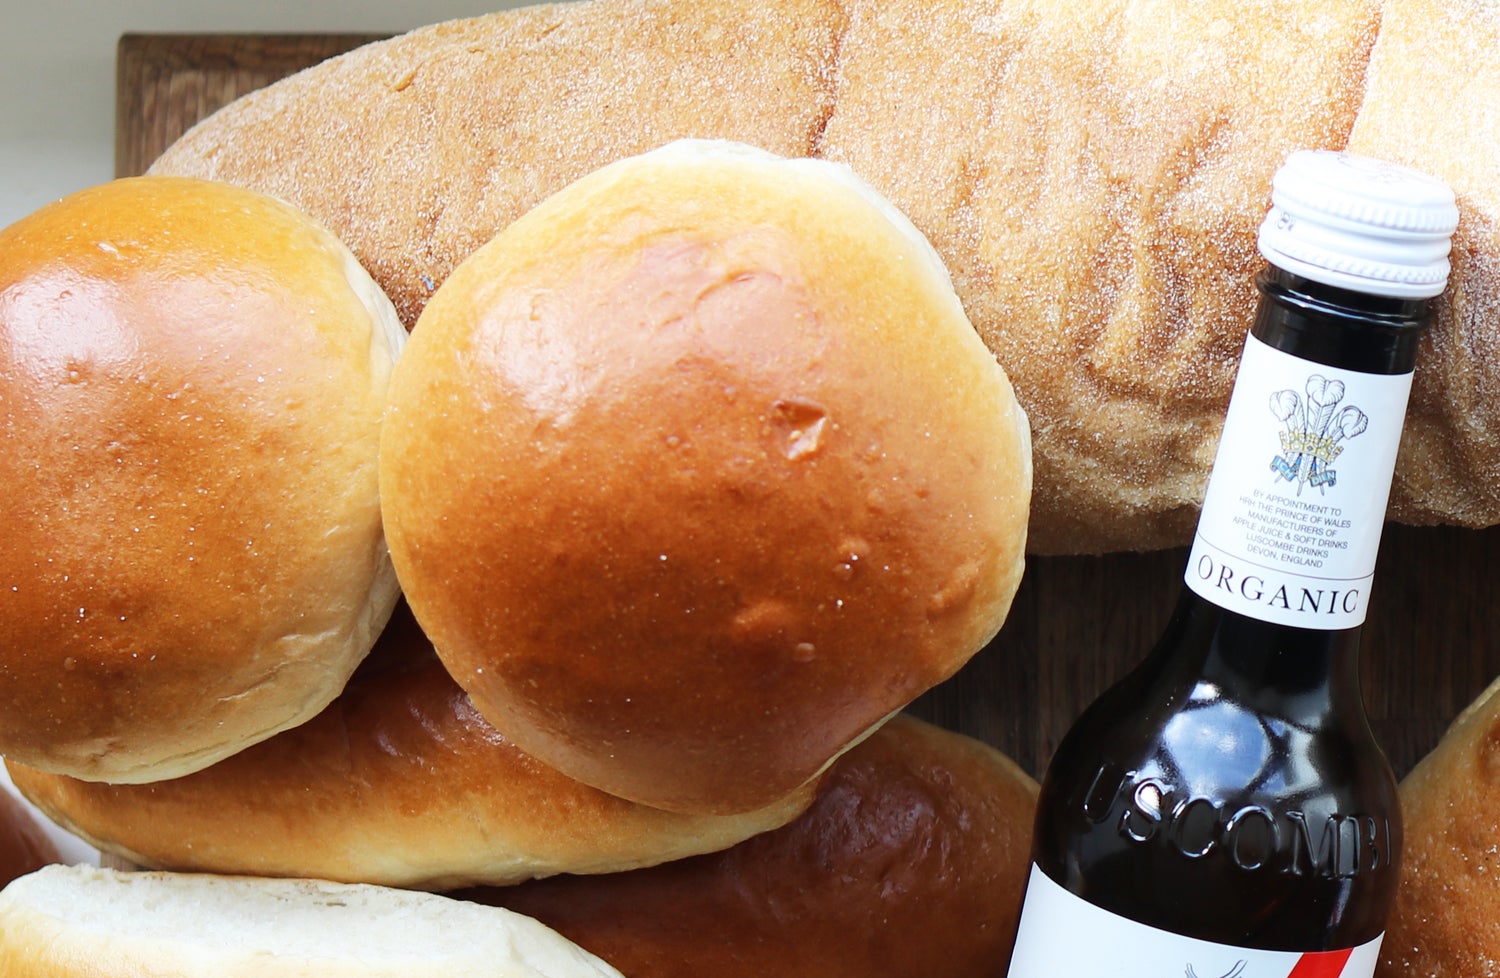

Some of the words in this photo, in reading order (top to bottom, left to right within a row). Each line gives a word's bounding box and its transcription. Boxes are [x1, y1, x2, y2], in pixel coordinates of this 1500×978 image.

[1239, 495, 1255, 506] HRH
[1258, 501, 1274, 514] THE
[1275, 507, 1308, 523] PRINCE
[1310, 515, 1322, 524] OF
[1324, 517, 1351, 529] WALES
[1253, 489, 1264, 498] BY
[1266, 494, 1329, 515] APPOINTMENT
[1331, 508, 1342, 517] TO
[1233, 516, 1256, 530] APPLE
[1258, 525, 1283, 539] JUICE
[1285, 532, 1291, 540] &
[1292, 534, 1317, 545] SOFT
[1318, 539, 1348, 550] DRINKS
[1247, 509, 1324, 536] MANUFACTURERS
[1325, 529, 1338, 538] OF
[1246, 532, 1295, 552] LUSCOMBE
[1296, 546, 1329, 559] DRINKS
[1247, 543, 1278, 560] DEVON,
[1281, 553, 1323, 568] ENGLAND
[1197, 554, 1360, 615] ORGANIC
